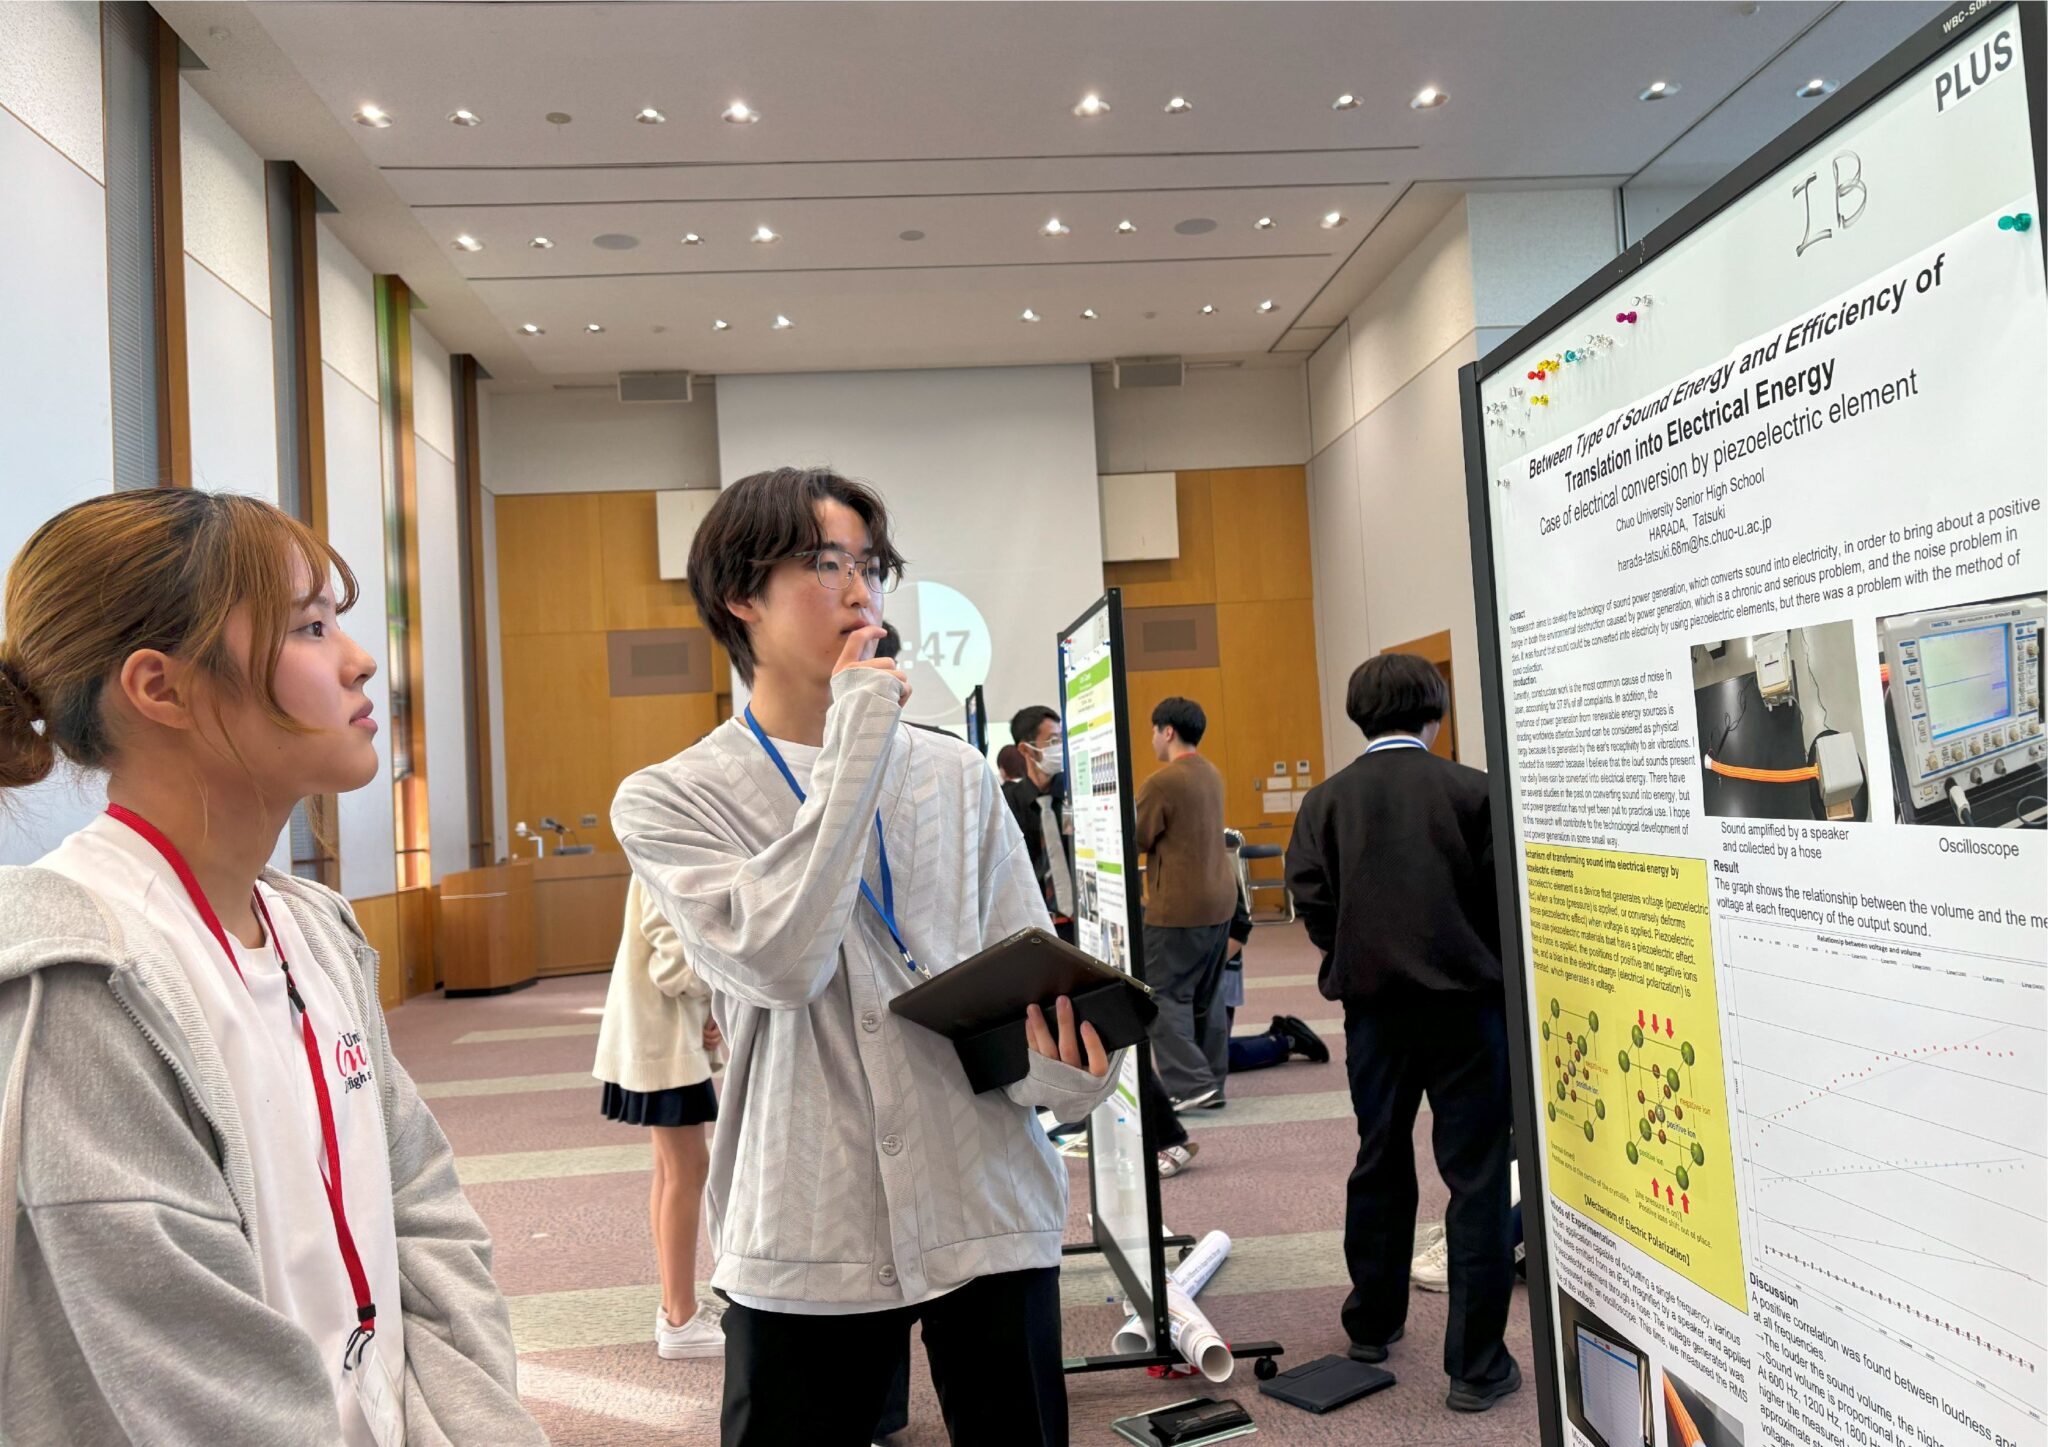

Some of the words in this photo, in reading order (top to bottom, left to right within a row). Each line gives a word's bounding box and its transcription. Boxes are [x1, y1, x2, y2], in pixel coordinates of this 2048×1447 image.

[1935, 31, 2012, 112] PLUS
[1529, 446, 1572, 479] Between
[1577, 427, 1602, 459] Type
[1607, 413, 1624, 439] of
[1622, 388, 1672, 429] Sound
[1673, 360, 1735, 406] Energy
[1739, 333, 1782, 374] and
[1785, 279, 1907, 353] Efficiency
[1916, 252, 1945, 293] of
[1565, 447, 1631, 493] Translation
[1636, 432, 1662, 462] into
[1667, 389, 1749, 447] Electrical
[1756, 358, 1835, 409] Energy
[1540, 509, 1561, 536] Case
[1563, 504, 1573, 528] of
[1575, 489, 1618, 522] electrical
[1622, 461, 1687, 504] conversion
[1692, 452, 1708, 477] by
[1714, 406, 1823, 472] piezoelectric
[1829, 368, 1918, 423] element
[1616, 517, 1634, 532] Chuo
[1637, 501, 1673, 524] University
[1676, 491, 1704, 511] Senior
[1707, 482, 1727, 501] High
[1730, 467, 1764, 492] School
[1649, 519, 1688, 542] HARADA,
[1693, 504, 1725, 528] Tatsuki
[1618, 516, 1772, 572] harada-tatsuki.68m@hs.chuo-u.ac.jp
[1711, 568, 1743, 584] converts
[1745, 560, 1771, 577] sound
[1774, 557, 1789, 571] into
[1793, 544, 1841, 566] electricity,
[1844, 541, 1853, 554] in
[1857, 534, 1886, 551] order
[1890, 530, 1900, 544] to
[1904, 523, 1932, 541] bring
[1937, 512, 1973, 532] about
[1977, 511, 1985, 524] a
[1989, 498, 2040, 525] positive
[1716, 591, 1722, 602] is
[1725, 590, 1729, 600] a
[1732, 584, 1762, 599] chronic
[1764, 578, 1780, 591] and
[1783, 571, 1816, 588] serious
[1819, 561, 1865, 583] problem,
[1868, 554, 1889, 571] and
[1893, 550, 1910, 565] the
[1914, 544, 1945, 560] noise
[1950, 531, 2002, 557] problem
[2006, 527, 2018, 542] in
[1690, 604, 1734, 628] piezoelectric
[1736, 600, 1777, 618] elements,
[1780, 597, 1794, 610] but
[1797, 591, 1820, 605] there
[1822, 587, 1844, 601] was
[1847, 586, 1854, 596] a
[1857, 575, 1901, 598] problem
[1905, 568, 1928, 586] with
[1933, 564, 1951, 581] the
[1956, 553, 2003, 576] method
[2007, 549, 2021, 566] of
[1669, 772, 1685, 783] have
[1721, 821, 1745, 834] Sound
[1749, 823, 1785, 838] amplified
[1788, 825, 1798, 840] by
[1802, 828, 1807, 838] a
[1810, 826, 1849, 842] speaker
[1723, 841, 1737, 852] and
[1739, 842, 1775, 855] collected
[1778, 844, 1789, 859] by
[1791, 847, 1796, 857] a
[1799, 844, 1821, 859] hose
[1939, 838, 2020, 859] Oscilloscope
[1647, 863, 1669, 877] energy
[1671, 865, 1679, 879] by
[1714, 860, 1739, 873] Result
[1715, 877, 1730, 891] The
[1732, 880, 1753, 896] graph
[1756, 883, 1783, 898] shows
[1785, 885, 1799, 899] the
[1802, 888, 1857, 909] relationship
[1861, 893, 1906, 912] between
[1909, 899, 1927, 914] the
[1931, 903, 1974, 920] volume
[1978, 909, 2001, 923] and
[2006, 910, 2026, 926] the
[1716, 897, 1744, 913] voltage
[1746, 901, 1754, 911] at
[1756, 903, 1776, 916] each
[1778, 905, 1823, 925] frequency
[1827, 910, 1835, 923] of
[1838, 912, 1854, 926] the
[1858, 916, 1890, 932] output
[1893, 922, 1931, 937] sound.
[1619, 1216, 1624, 1226] of
[1626, 1219, 1647, 1240] Electric
[1750, 1272, 1799, 1309] Discussion
[1708, 1335, 1721, 1350] and
[1724, 1345, 1750, 1369] applied
[1714, 1321, 1741, 1345] various
[1754, 1311, 1761, 1324] at
[1764, 1317, 1772, 1331] all
[1774, 1320, 1826, 1363] frequencies.
[1669, 1341, 1679, 1354] we
[1681, 1349, 1714, 1379] measured
[1716, 1371, 1727, 1388] the
[1730, 1381, 1748, 1403] RMS
[1729, 1367, 1744, 1383] was
[1752, 1291, 1758, 1303] A
[1760, 1297, 1791, 1322] positive
[1794, 1315, 1839, 1351] correlation
[1841, 1343, 1861, 1363] was
[1863, 1353, 1891, 1380] found
[1894, 1370, 1939, 1408] between
[1942, 1397, 1991, 1441] loudness
[1782, 1343, 1808, 1370] louder
[1810, 1361, 1824, 1380] the
[1827, 1373, 1855, 1399] sound
[1857, 1392, 1895, 1426] volume,
[1898, 1414, 1914, 1435] the
[1758, 1365, 1766, 1380] At
[1768, 1372, 1784, 1390] 600
[1787, 1382, 1801, 1403] Hz,
[1804, 1394, 1824, 1417] 1200
[1827, 1408, 1842, 1431] Hz,
[1845, 1421, 1866, 1446] 1800
[1759, 1382, 1784, 1406] higher
[1786, 1401, 1800, 1419] the
[1802, 1413, 1844, 1447] measured
[1760, 1403, 1810, 1445] approximate
[1765, 1352, 1792, 1378] Sound
[1794, 1371, 1825, 1399] volume
[1827, 1394, 1835, 1405] is
[1838, 1401, 1893, 1444] proportional
